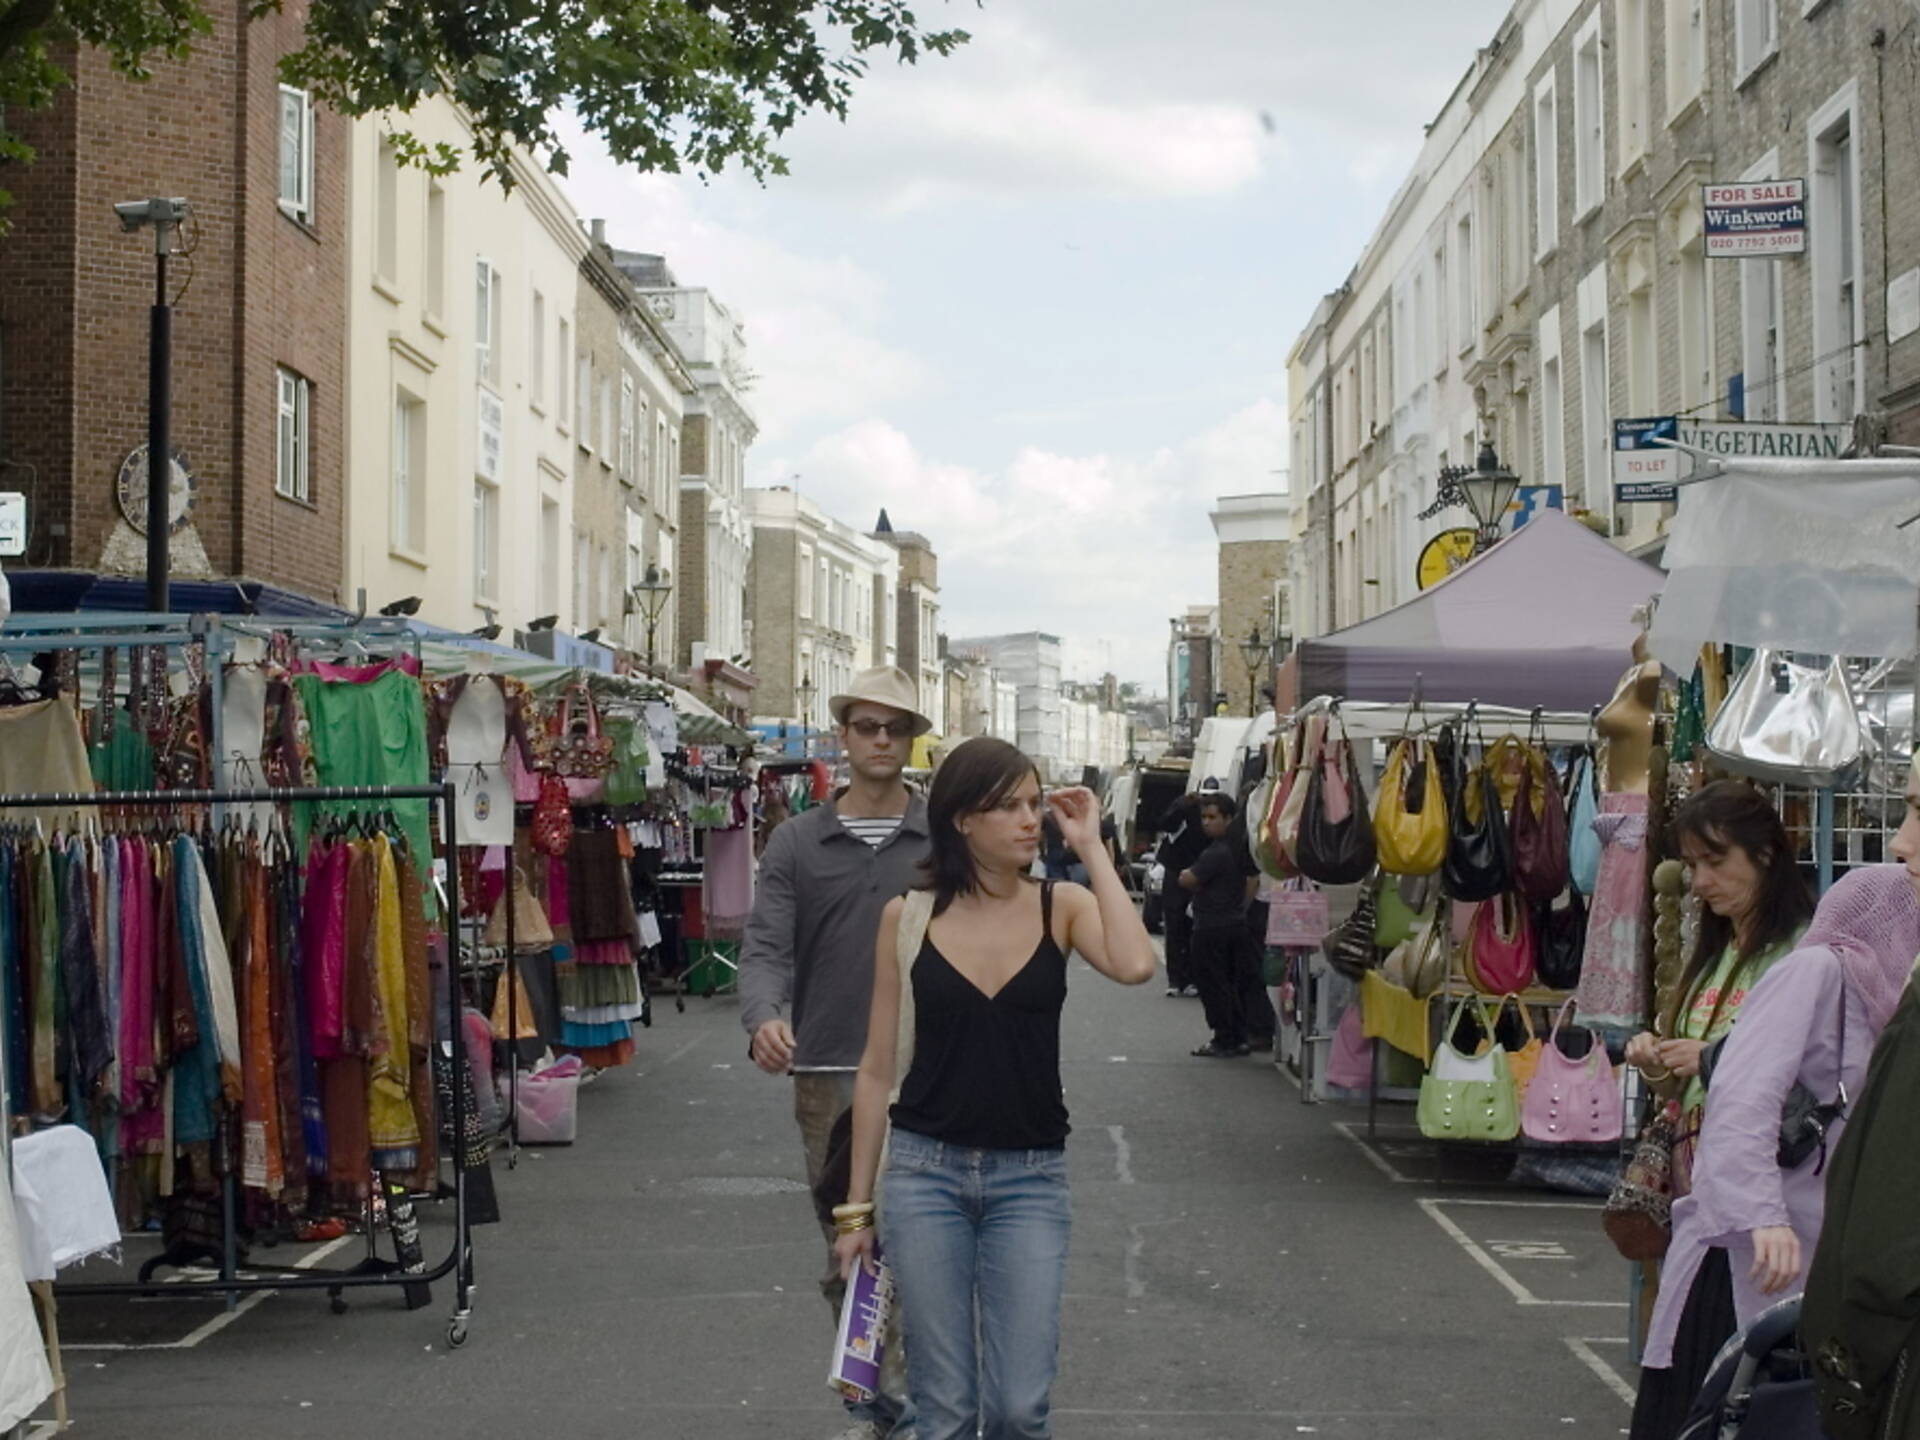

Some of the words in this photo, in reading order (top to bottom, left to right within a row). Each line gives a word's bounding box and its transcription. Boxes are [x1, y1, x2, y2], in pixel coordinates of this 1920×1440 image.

[1711, 188, 1746, 202] FOR
[1752, 185, 1796, 200] SALE
[1706, 205, 1803, 226] Winkworth
[1683, 430, 1839, 457] VEGETARIAN
[1628, 461, 1642, 472] TO
[1647, 459, 1665, 471] LET
